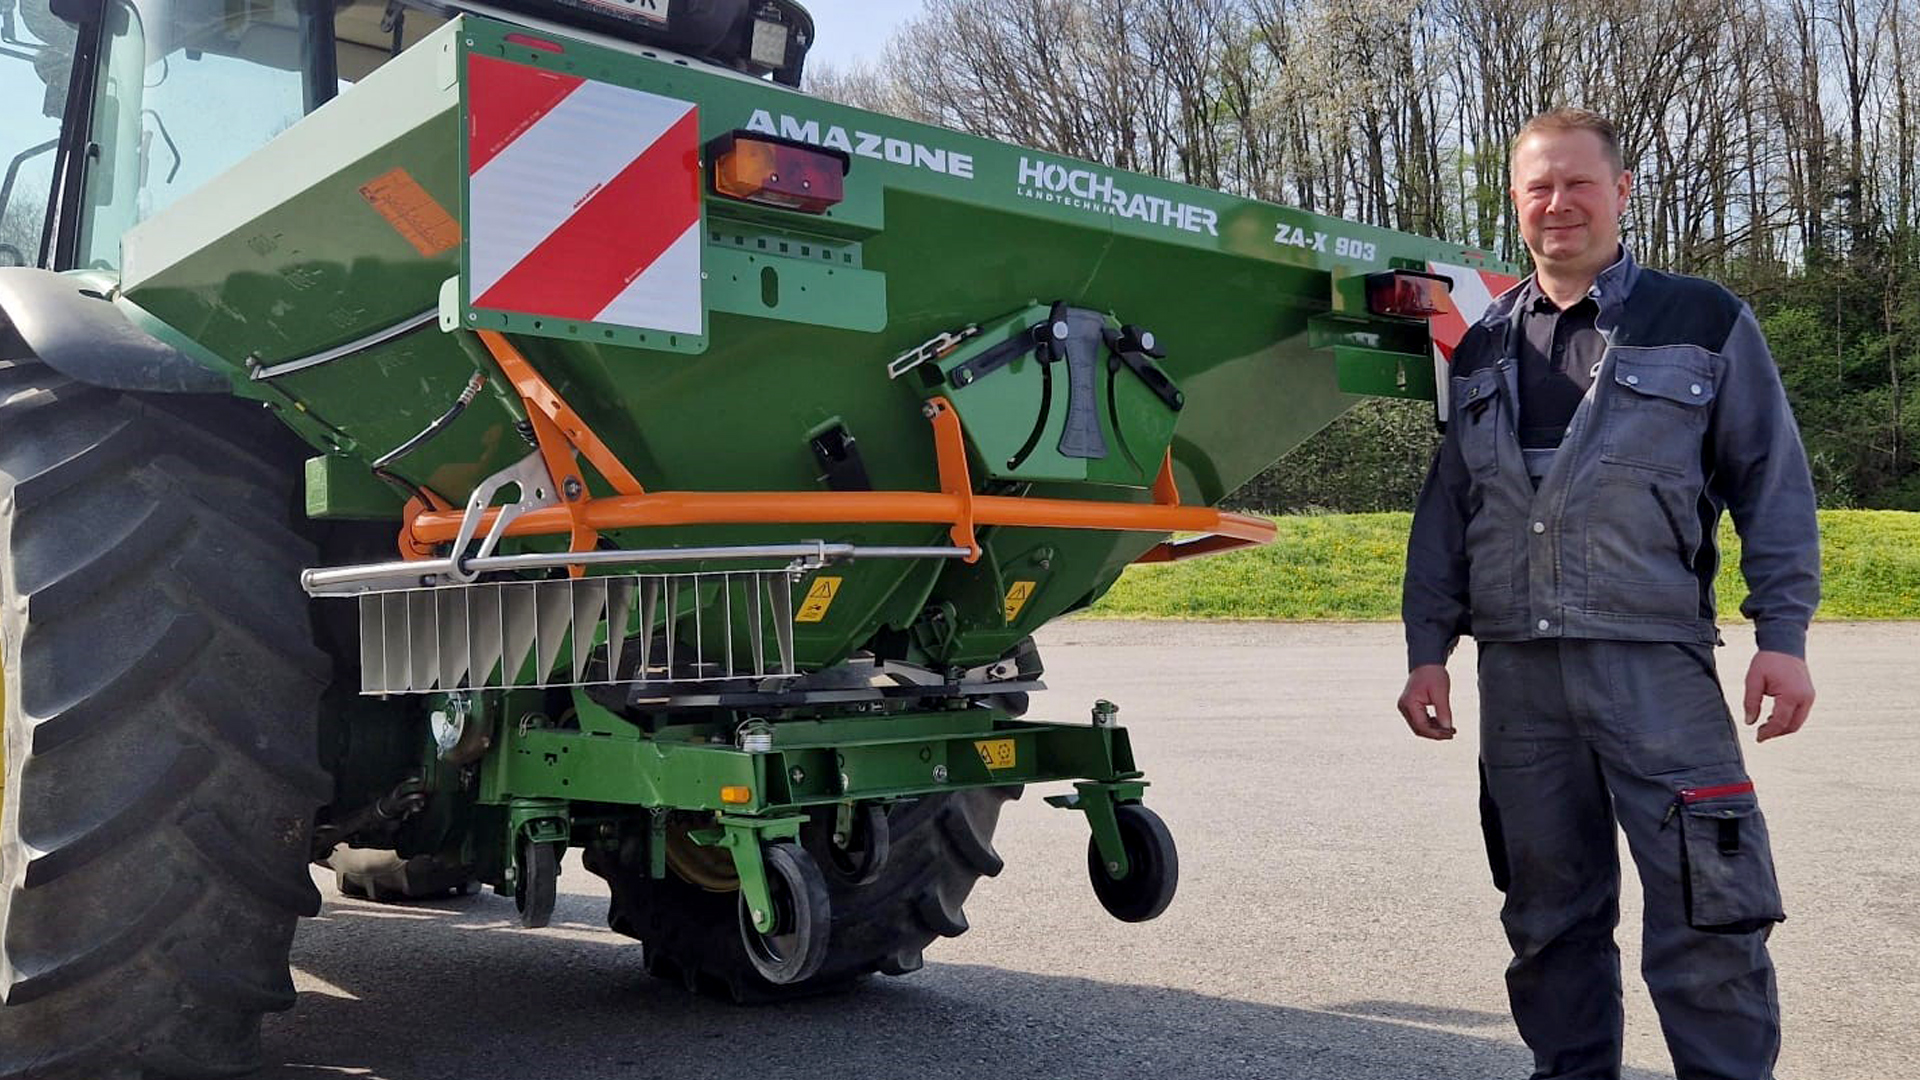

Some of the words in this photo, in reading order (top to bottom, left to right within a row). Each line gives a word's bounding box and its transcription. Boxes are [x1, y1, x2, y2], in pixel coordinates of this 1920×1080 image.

[745, 108, 974, 180] AMAZONE
[1017, 187, 1116, 216] LANDTECHNIK
[1274, 223, 1328, 253] ZA-X
[1335, 236, 1377, 262] 903
